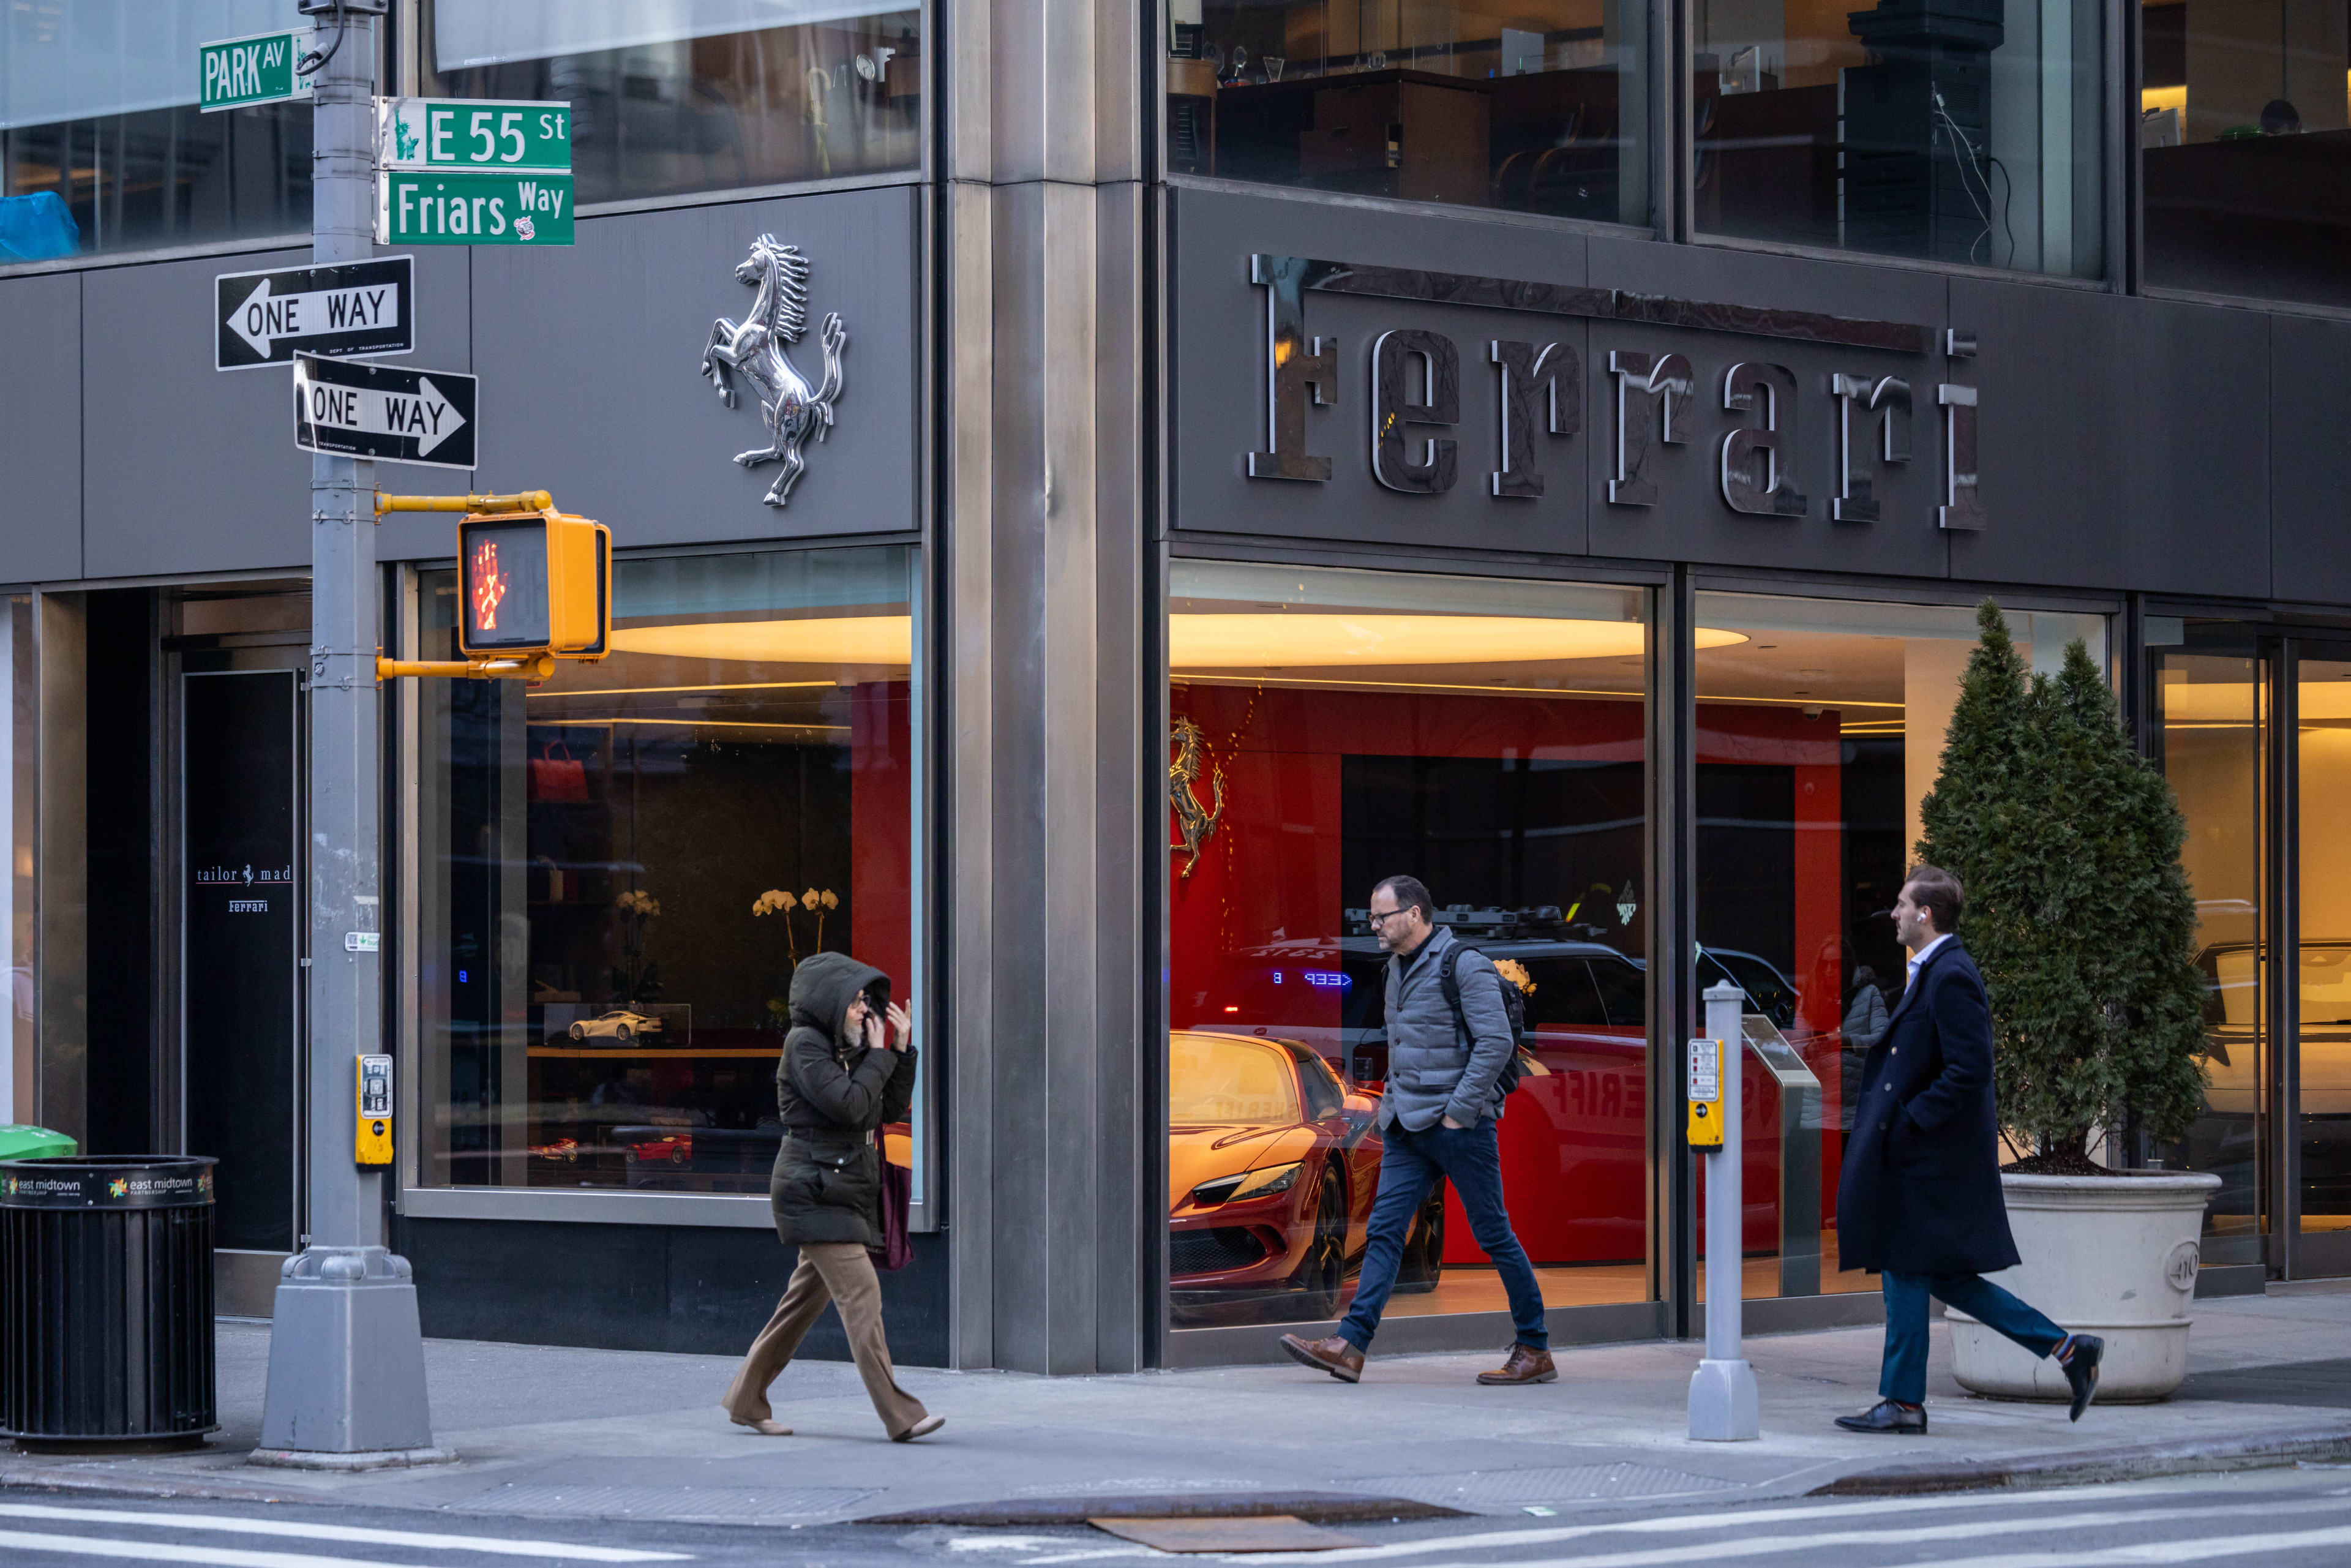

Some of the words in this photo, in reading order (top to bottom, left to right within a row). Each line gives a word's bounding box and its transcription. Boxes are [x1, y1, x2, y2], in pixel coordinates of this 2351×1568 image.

[206, 44, 261, 101] PARK
[263, 41, 285, 69] AV
[431, 111, 455, 160] E
[470, 111, 525, 163] 55
[539, 113, 565, 140] St
[399, 184, 506, 235] Friars
[518, 181, 564, 219] Way
[247, 298, 300, 337] ONE
[328, 290, 386, 329] WAY
[313, 386, 358, 426] ONE
[386, 397, 446, 435] WAY
[1249, 253, 1987, 531] Ferrari
[318, 441, 356, 451] TRANSPORTATION
[197, 866, 237, 881] tailor
[261, 865, 291, 880] mad
[228, 900, 268, 912] Ferrari
[18, 1180, 34, 1190] east
[36, 1179, 80, 1191] midtown
[130, 1179, 152, 1190] east
[154, 1177, 193, 1190] midtown
